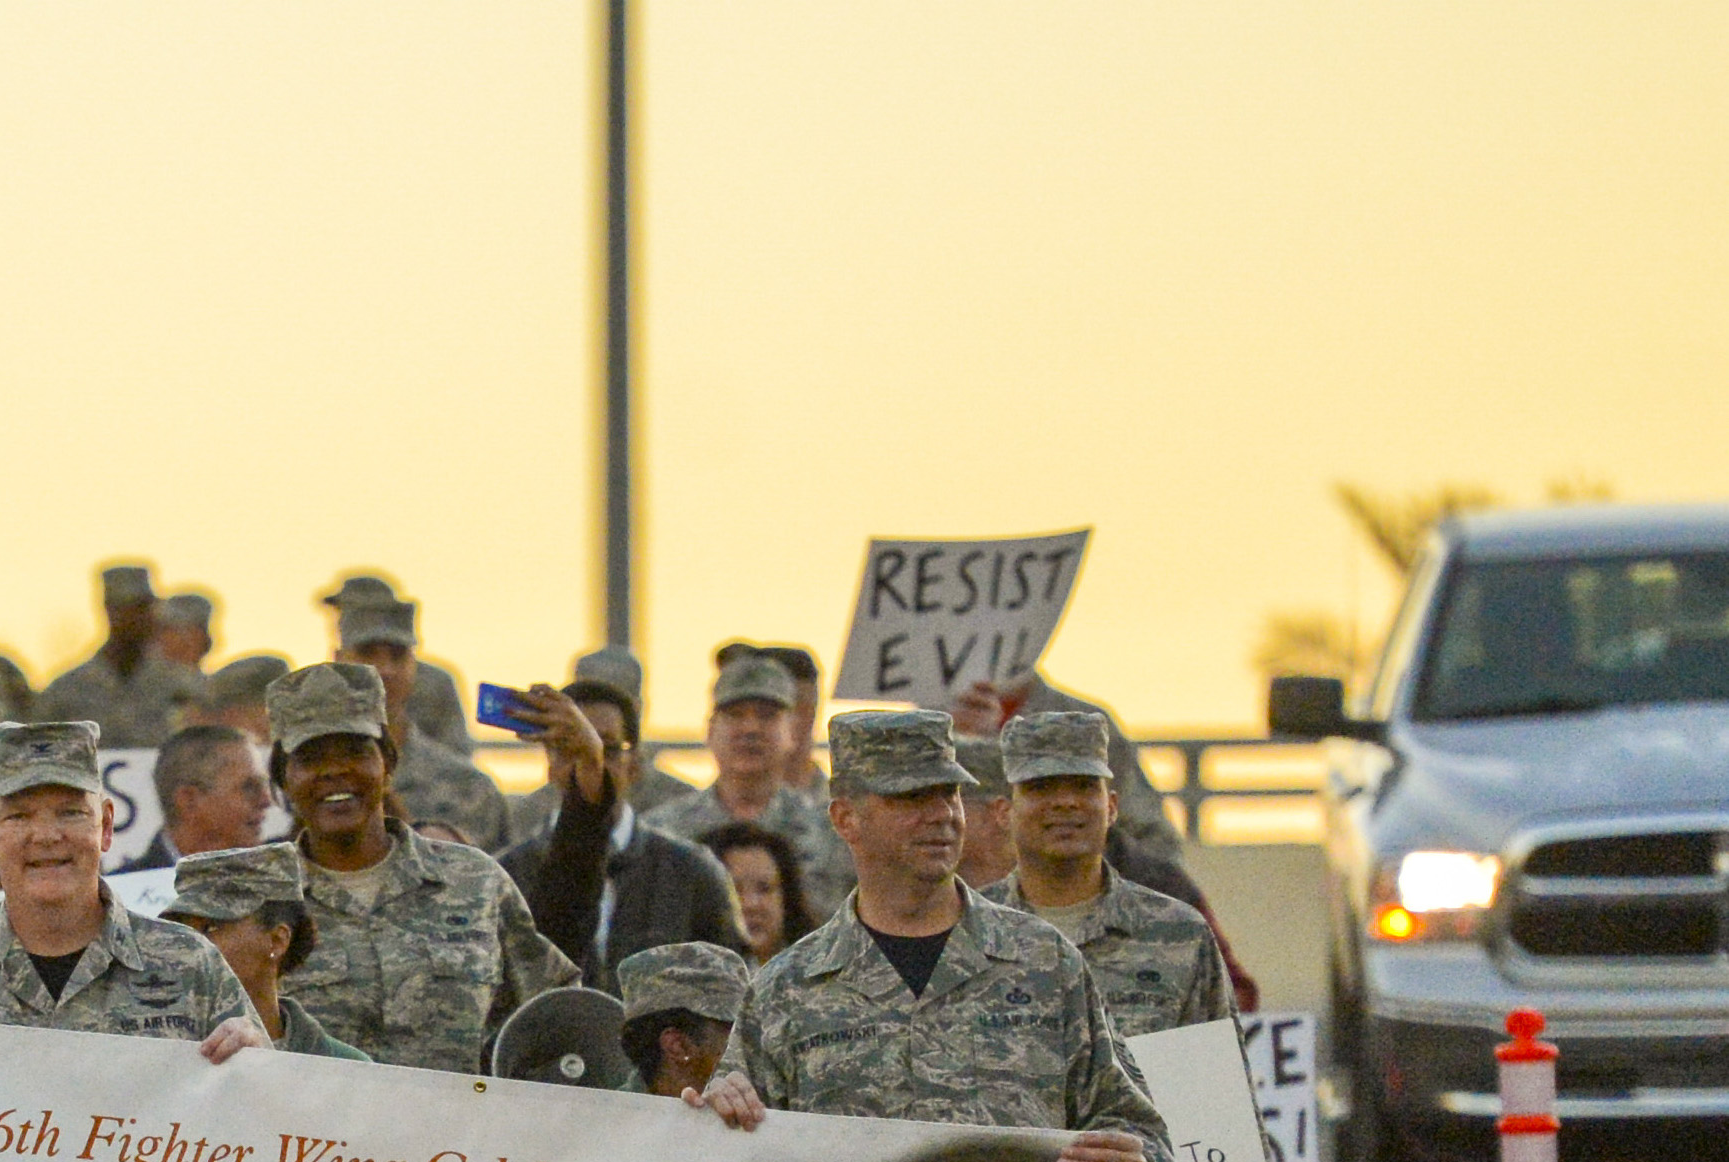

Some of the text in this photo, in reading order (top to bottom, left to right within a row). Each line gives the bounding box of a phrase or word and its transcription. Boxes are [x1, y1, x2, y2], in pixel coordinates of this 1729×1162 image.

[871, 547, 1076, 619] RESIST
[876, 626, 1034, 693] EVIL
[143, 1016, 164, 1030] AIR
